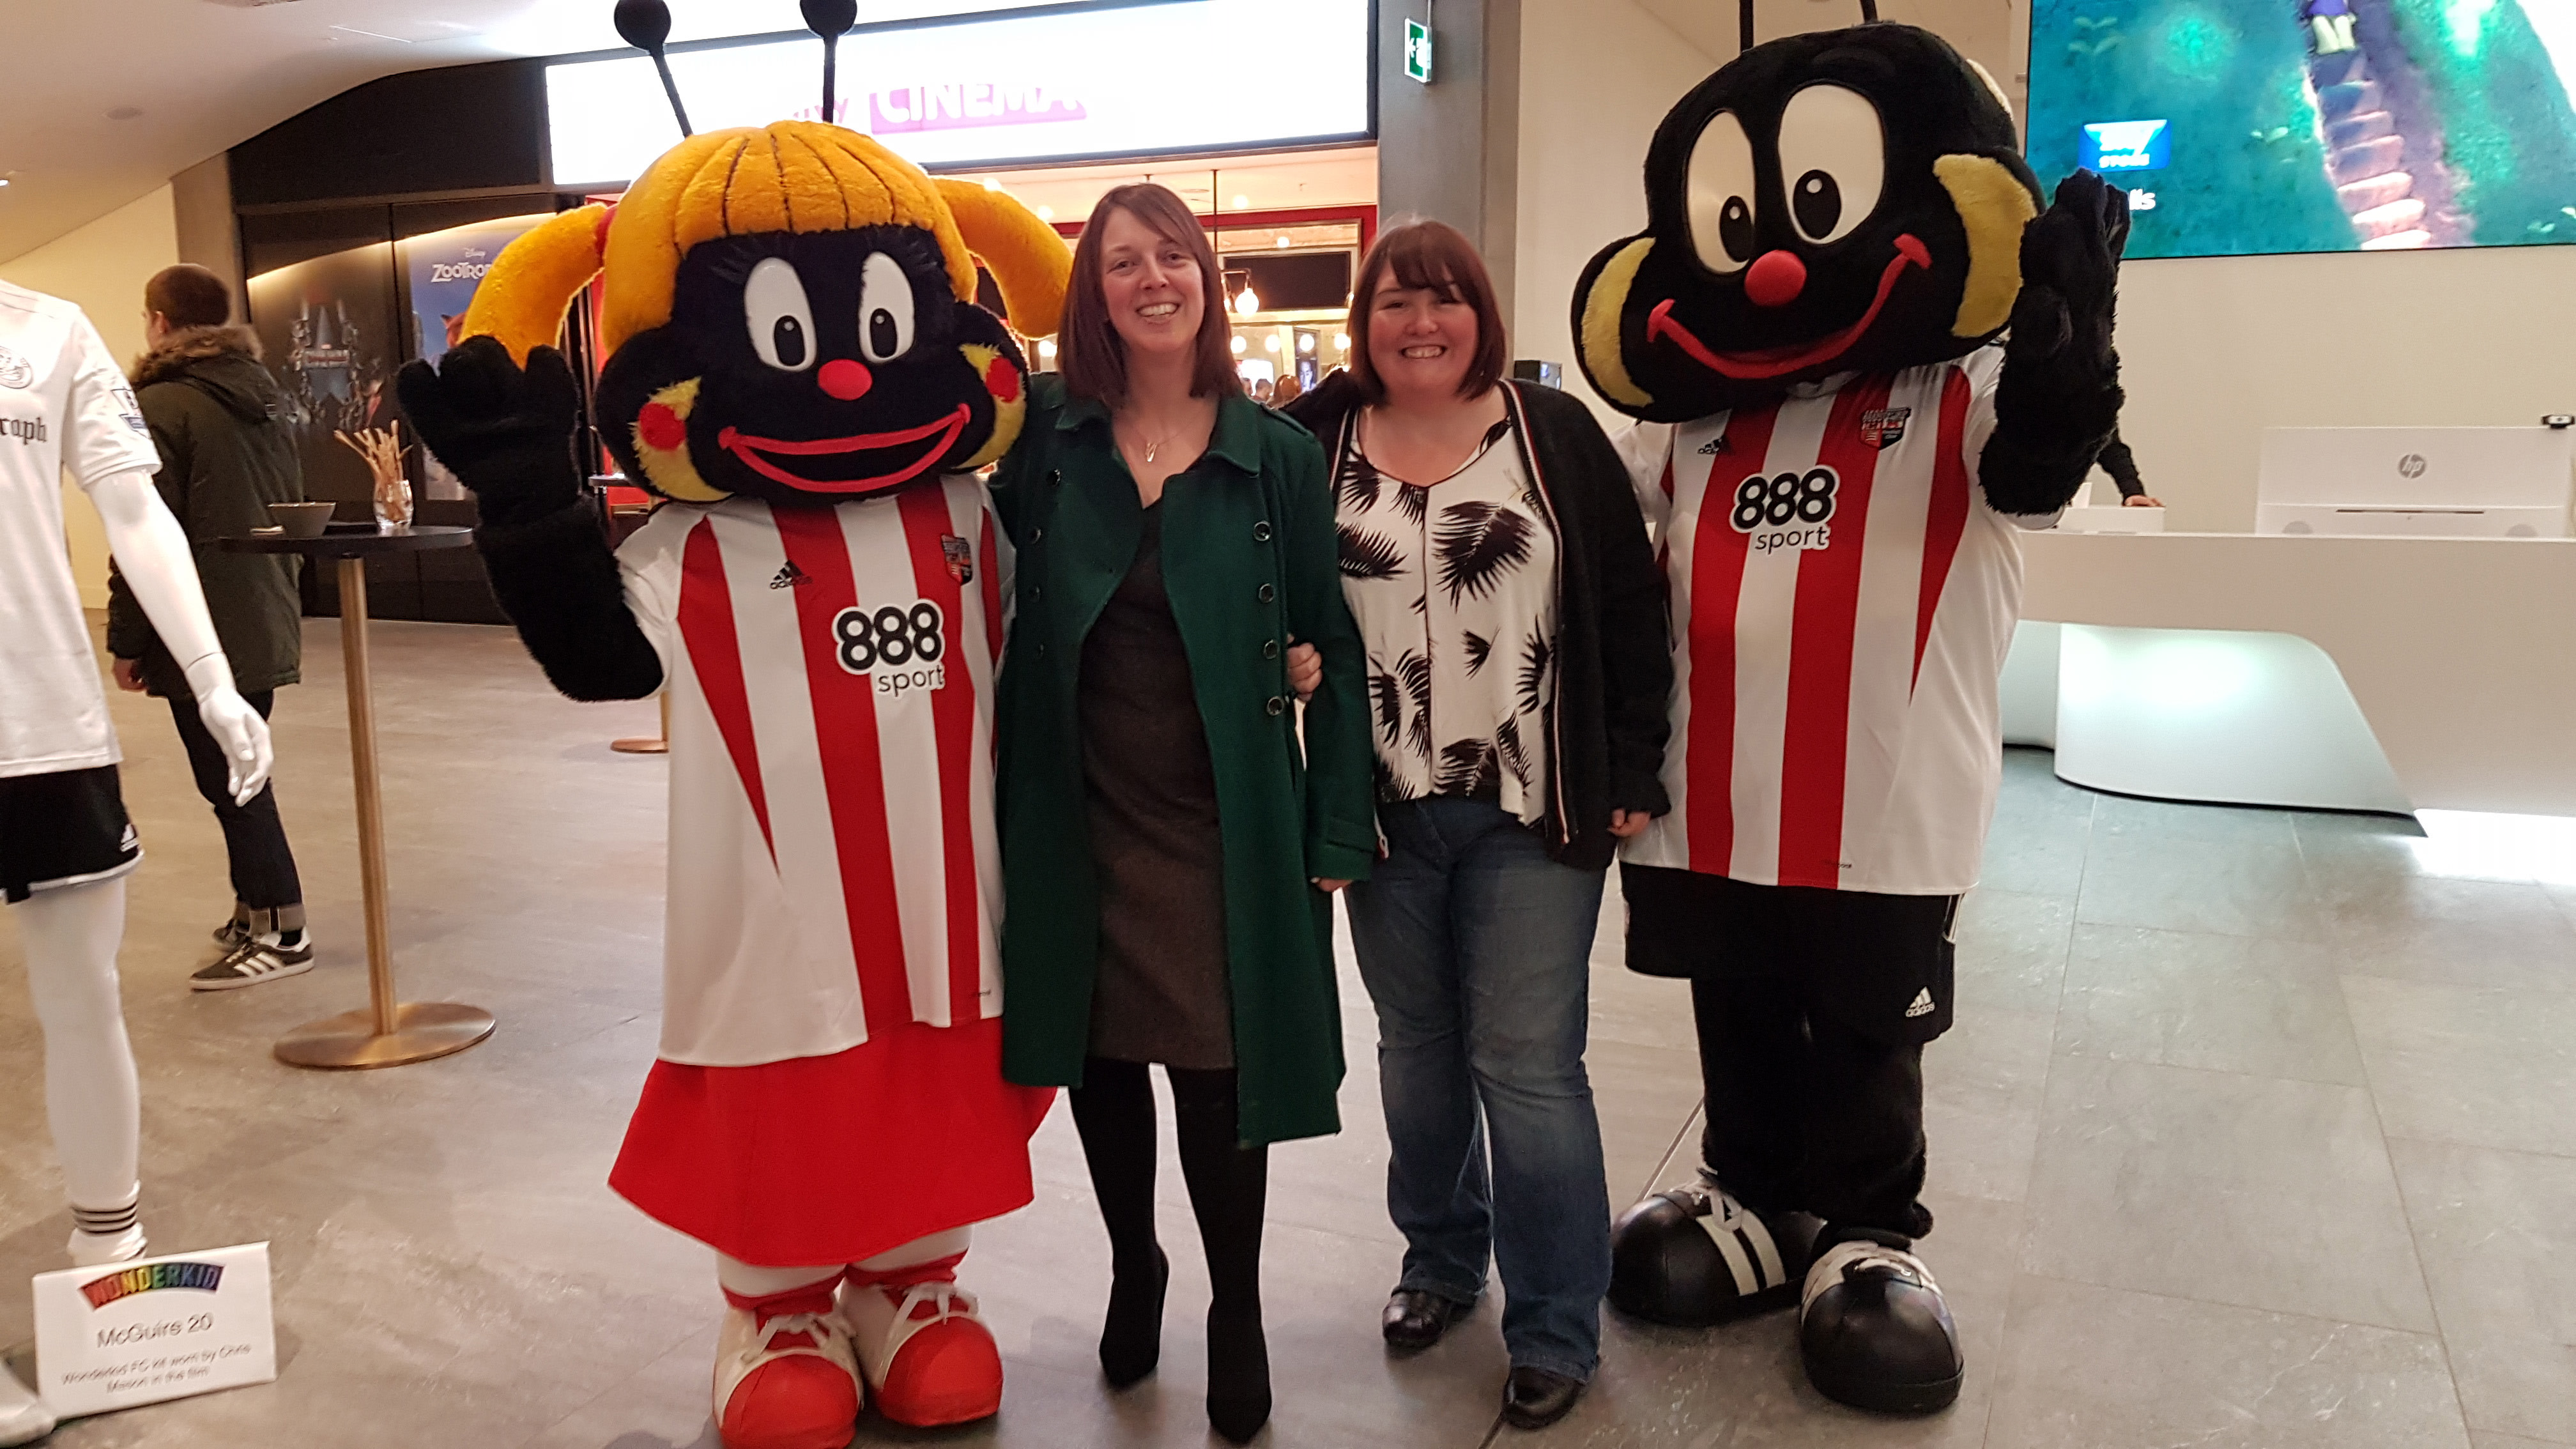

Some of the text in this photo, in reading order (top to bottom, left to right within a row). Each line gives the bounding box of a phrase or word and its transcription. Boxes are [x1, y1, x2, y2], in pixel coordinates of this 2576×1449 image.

[1733, 468, 1836, 530] 888
[1754, 526, 1828, 555] sport
[836, 602, 942, 671] 888
[878, 664, 944, 698] sport
[96, 1312, 215, 1348] McGuire 20
[130, 1359, 151, 1374] FC
